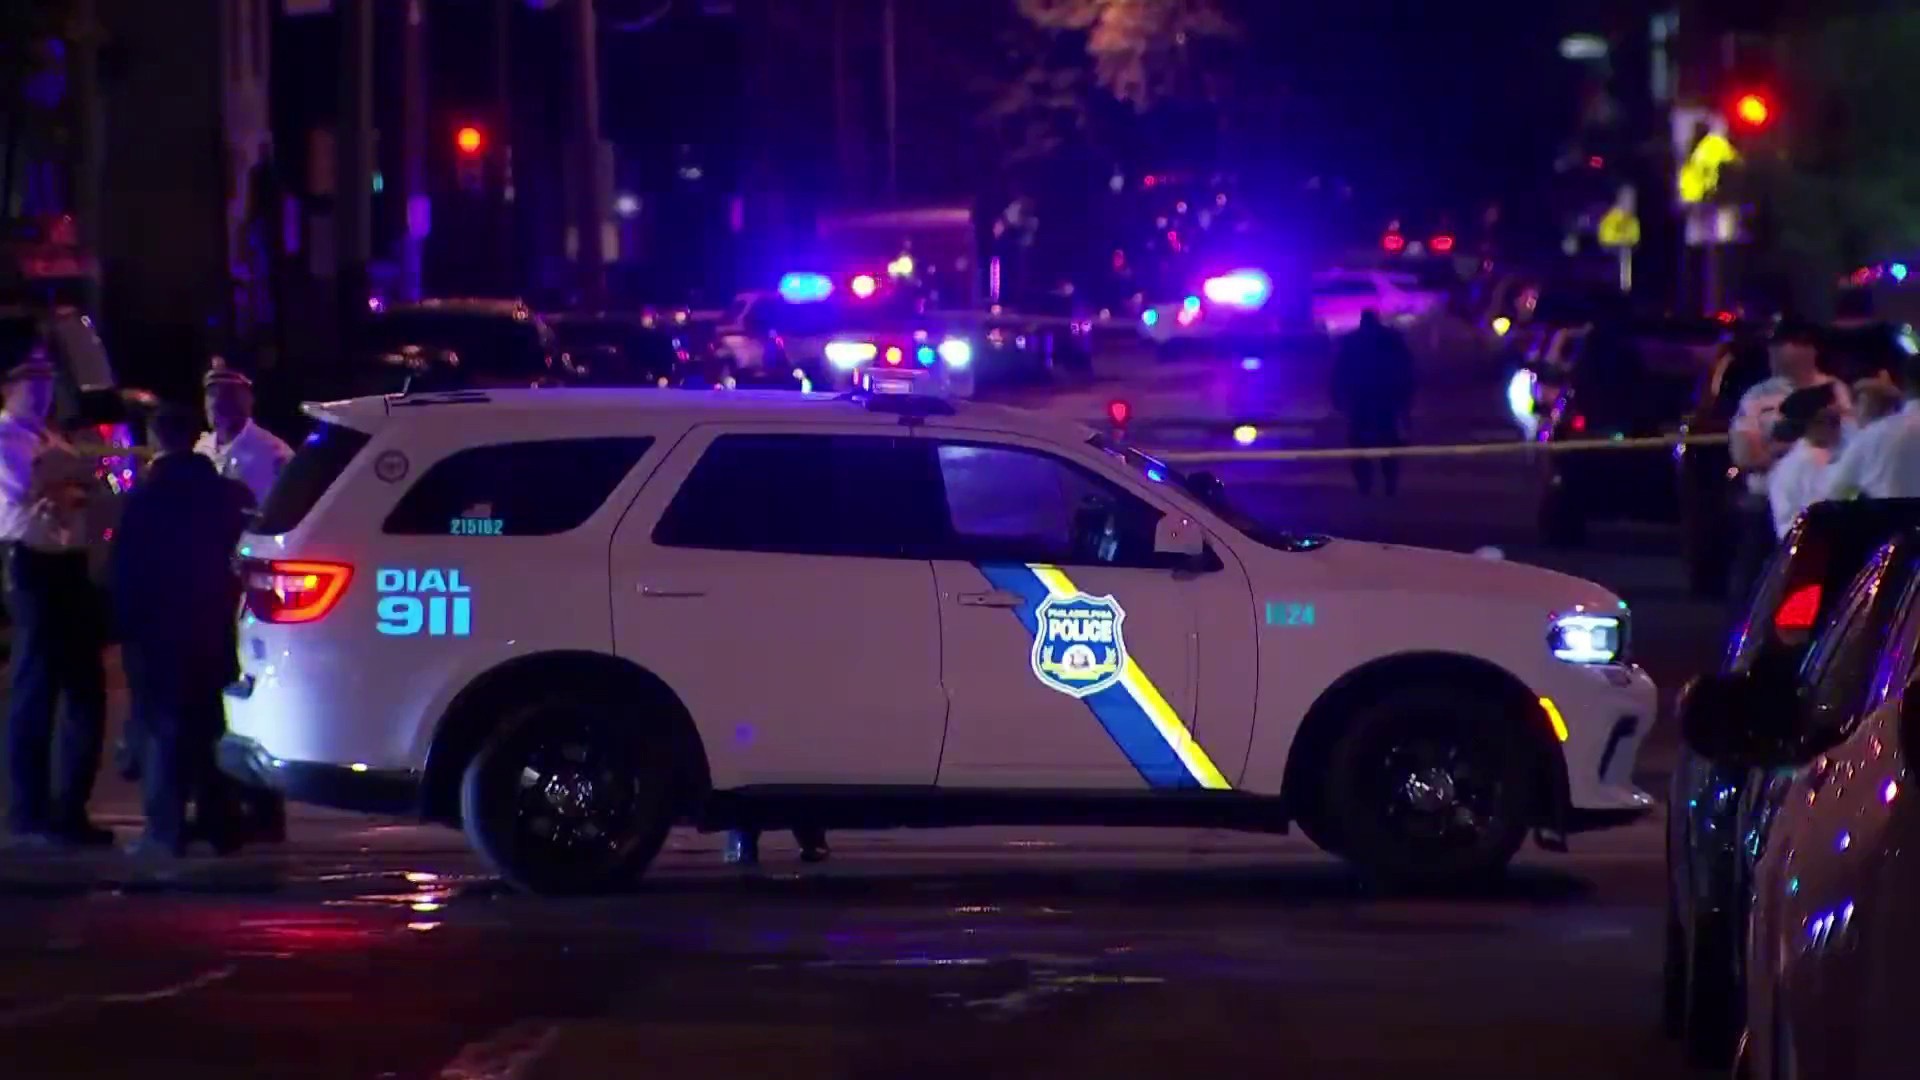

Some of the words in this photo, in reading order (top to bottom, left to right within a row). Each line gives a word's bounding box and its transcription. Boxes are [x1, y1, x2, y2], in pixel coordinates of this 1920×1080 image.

[377, 569, 470, 592] DIAL
[377, 597, 470, 635] 911
[1049, 619, 1113, 642] POLICE
